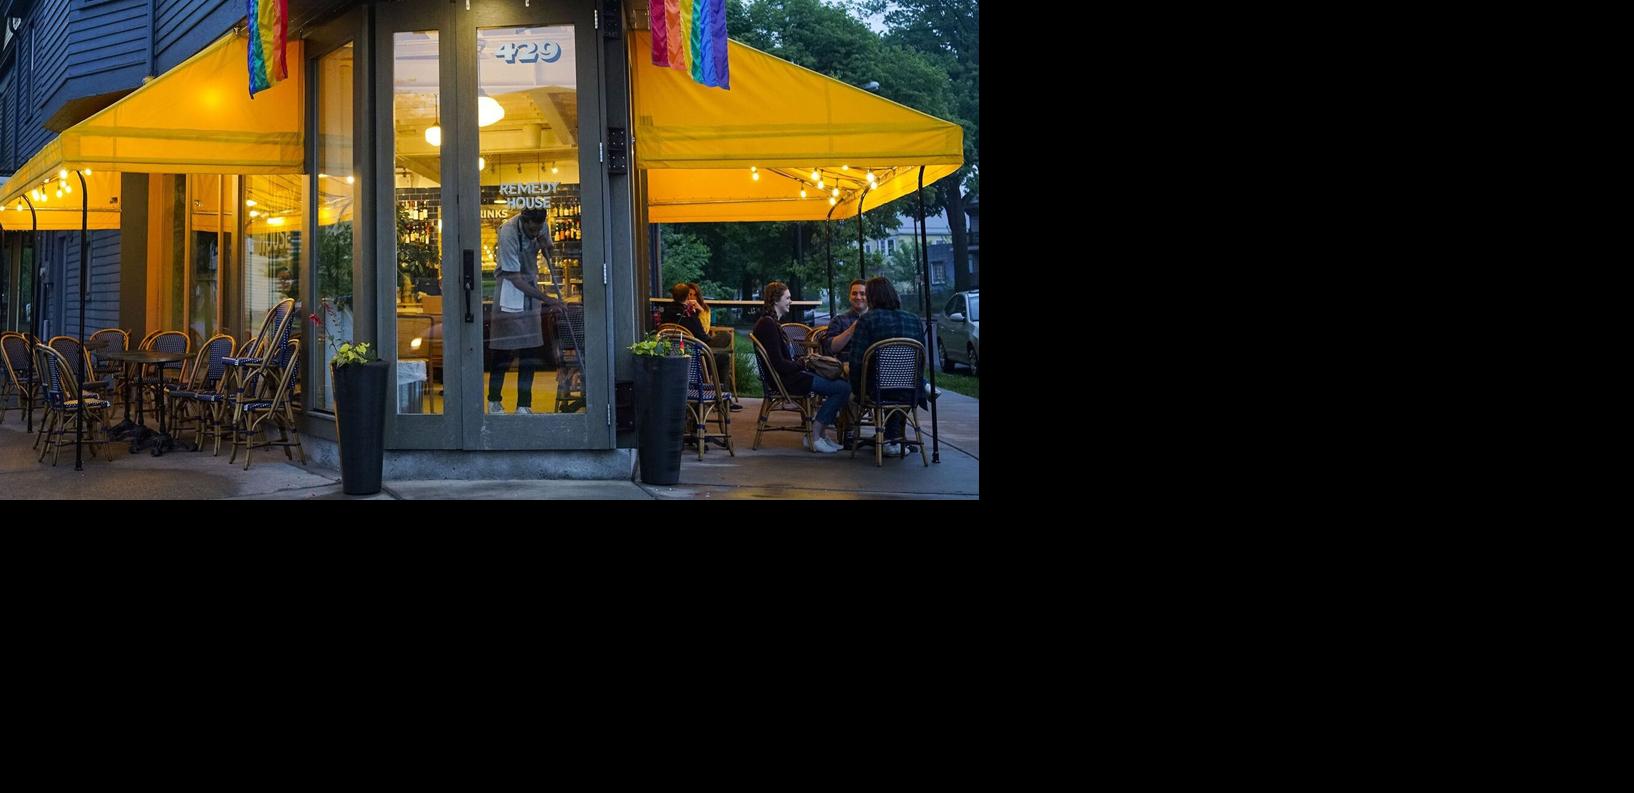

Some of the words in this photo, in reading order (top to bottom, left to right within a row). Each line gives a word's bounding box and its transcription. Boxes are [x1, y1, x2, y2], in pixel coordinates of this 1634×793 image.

[495, 40, 561, 64] 429
[499, 182, 561, 195] REMEDY
[506, 195, 552, 210] HOUSE
